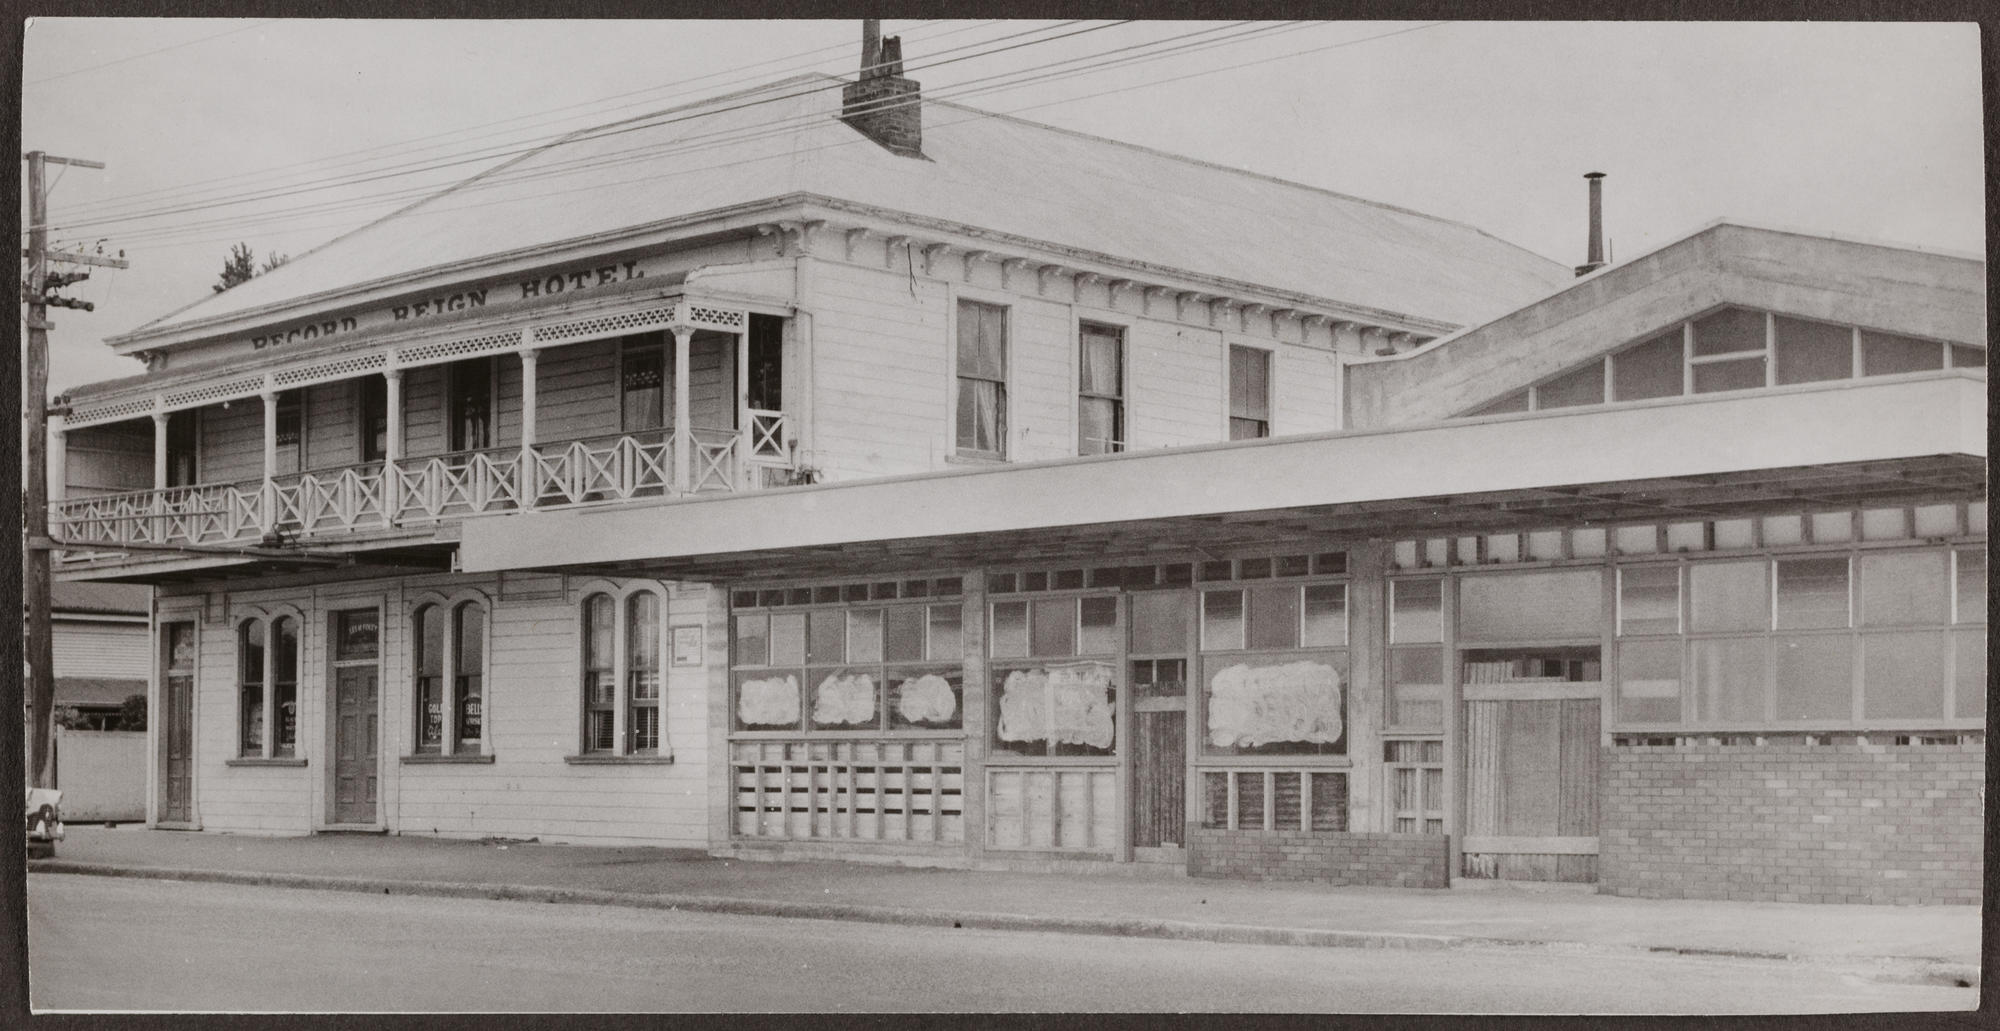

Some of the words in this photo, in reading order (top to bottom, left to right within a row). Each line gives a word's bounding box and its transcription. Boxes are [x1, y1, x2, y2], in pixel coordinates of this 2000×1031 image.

[251, 316, 358, 351] RECORD
[391, 289, 489, 321] REIGN
[520, 259, 645, 298] HOTEL
